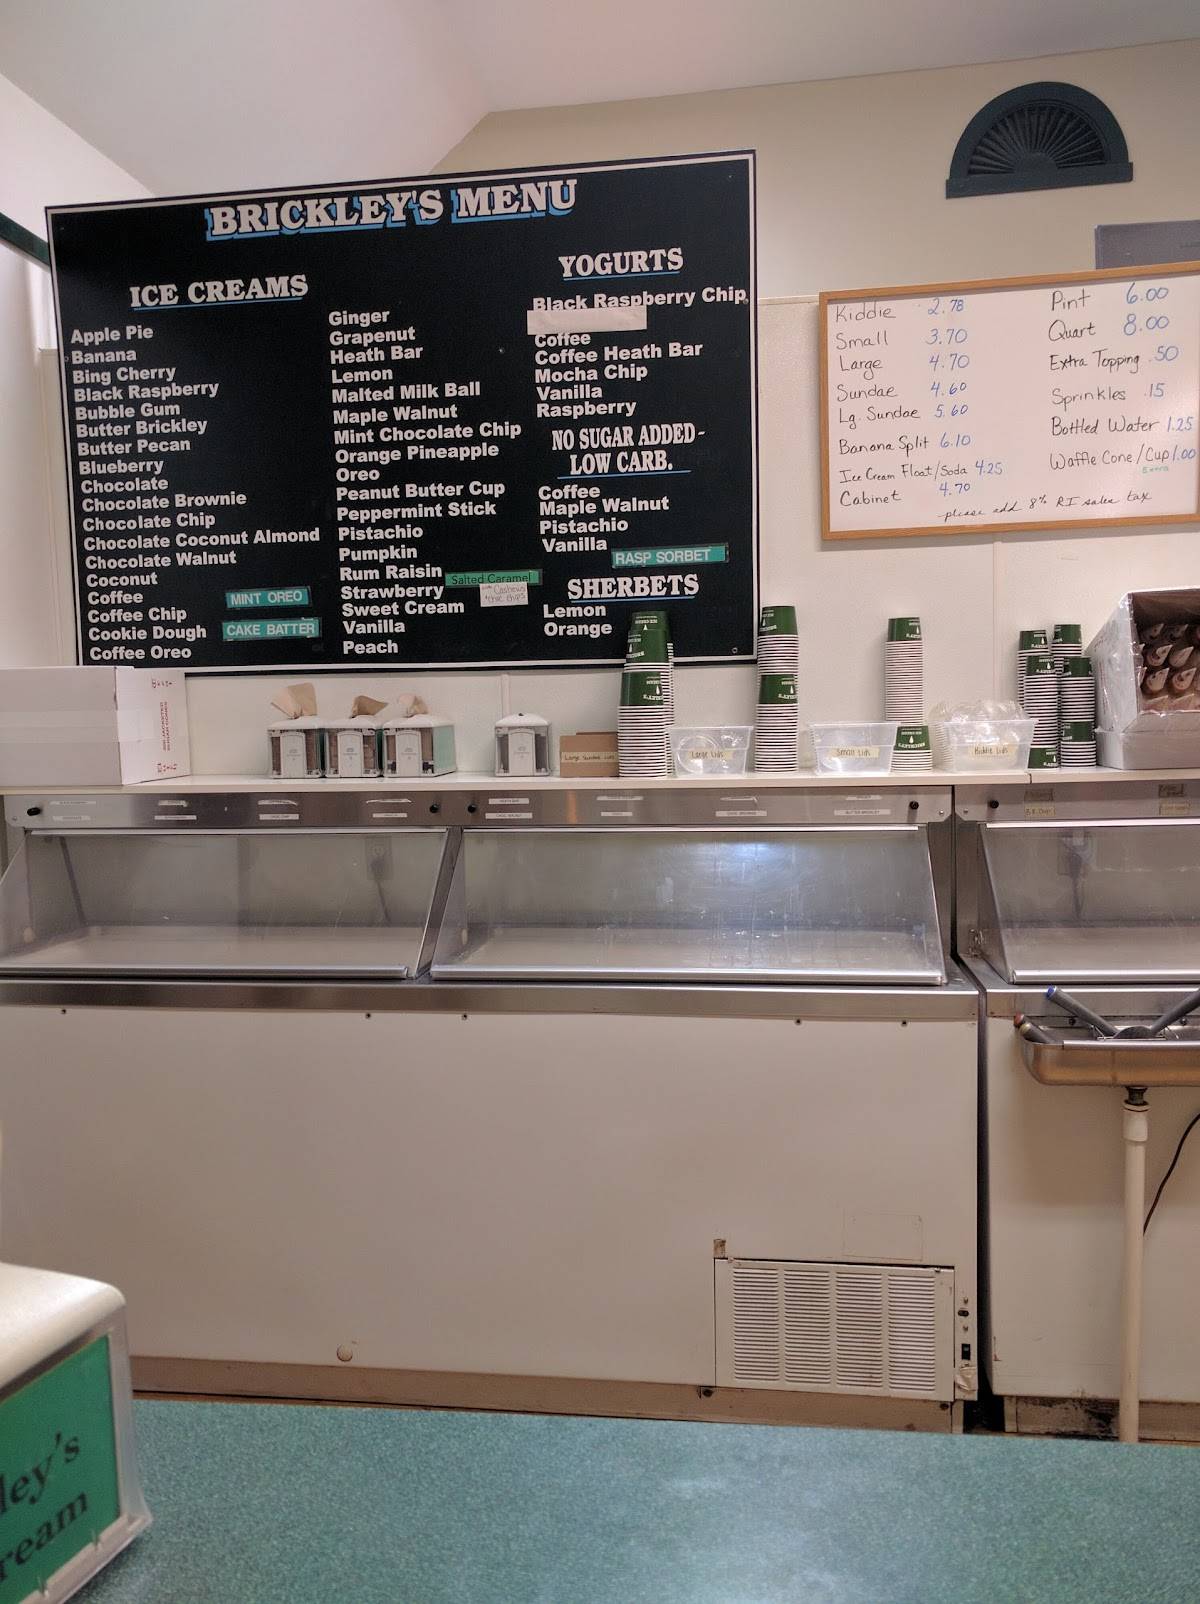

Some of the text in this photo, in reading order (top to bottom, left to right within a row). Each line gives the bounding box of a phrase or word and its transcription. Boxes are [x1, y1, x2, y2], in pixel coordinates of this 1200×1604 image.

[207, 178, 578, 239] BRICKLEY'S MENU
[558, 247, 684, 278] YOGURTS
[129, 274, 309, 308] ICE CREAMS
[532, 285, 746, 311] Black Raspberry Chip
[1052, 282, 1169, 311] Pint 6.00
[328, 310, 390, 328] Ginger
[835, 302, 896, 322] Kiddie
[70, 324, 154, 347] Apple Pie
[329, 326, 416, 347] Grapenut
[1048, 313, 1169, 342] Quart 8.00
[534, 333, 591, 348] Coffee
[836, 328, 968, 350] Small 3.70
[71, 350, 137, 365] Banana
[330, 345, 424, 365] Heath Bar
[534, 341, 704, 366] Coffee Heath Bar
[1050, 354, 1088, 371] Extra
[1092, 348, 1140, 374] Topping
[72, 366, 176, 386] Bing Cherry
[331, 368, 393, 384] Lemon
[534, 363, 648, 384] Mocha Chip
[839, 353, 970, 380] Large 4.70
[73, 382, 220, 403] Black Raspberry
[331, 381, 481, 404] Malted Milk Ball
[536, 383, 603, 401] Vanilla
[837, 381, 967, 402] Sundae 4.60
[1052, 386, 1126, 411] Sprinkles
[75, 402, 181, 421] Bubble Gum
[333, 403, 458, 427] Maple Walnut
[536, 400, 637, 420] Raspberry
[866, 406, 921, 421] Sundae
[76, 418, 208, 438] Butter Brickley
[333, 421, 522, 445] Mint Chocolate Chip
[1051, 415, 1195, 436] Bottled Water 1.25
[77, 438, 191, 457] Butter Pecan
[551, 428, 575, 451] NO
[579, 425, 635, 450] SUGAR
[839, 432, 971, 457] Banana Split 6.10
[335, 442, 500, 465] Orange Pineapple
[569, 449, 674, 476] LOW CARB.
[1050, 451, 1097, 470] Waffle
[78, 459, 164, 475] Blueberry
[335, 467, 381, 482] Oreo
[839, 469, 861, 484] Ice
[866, 467, 896, 481] Cream
[975, 459, 1003, 476] 4.25
[80, 476, 169, 494] Chocolate
[336, 480, 506, 501] Peanut Butter Cup
[538, 484, 601, 501] Coffee
[839, 482, 971, 507] Cabinet 4.70
[81, 493, 247, 513] Chocolate Brownie
[539, 495, 670, 519] Maple Walnut
[993, 501, 1022, 514] add
[1127, 489, 1152, 504] tax
[82, 511, 216, 532] Chocolate Chip
[336, 500, 497, 524] Peppermint Stick
[338, 524, 424, 541] Pistachio
[539, 516, 629, 535] Pistachio
[83, 527, 320, 551] Chocolate Coconut Almond
[541, 536, 608, 553] Vanilla
[85, 550, 237, 570] Chocolate Walnut
[338, 544, 418, 563] Pumpkin
[614, 547, 711, 566] RASP SORBET
[86, 571, 158, 588] Coconut
[339, 563, 443, 581] Rum Raisin
[451, 571, 531, 585] Salted Caramel
[340, 583, 445, 600] Strawberry
[567, 573, 700, 600] SHERBETS
[87, 590, 144, 606] Coffee
[230, 590, 303, 606] MINT OREO
[87, 606, 187, 624] Coffee Chip
[342, 600, 465, 617] Sweet Cream
[543, 604, 607, 619] Lemon
[88, 624, 207, 642] Cookie Dough
[226, 621, 316, 637] CAKE BATTER
[342, 618, 406, 635] Vanilla
[543, 621, 613, 639] Orange
[89, 645, 192, 661] Coffee Oreo
[342, 639, 399, 655] Peach
